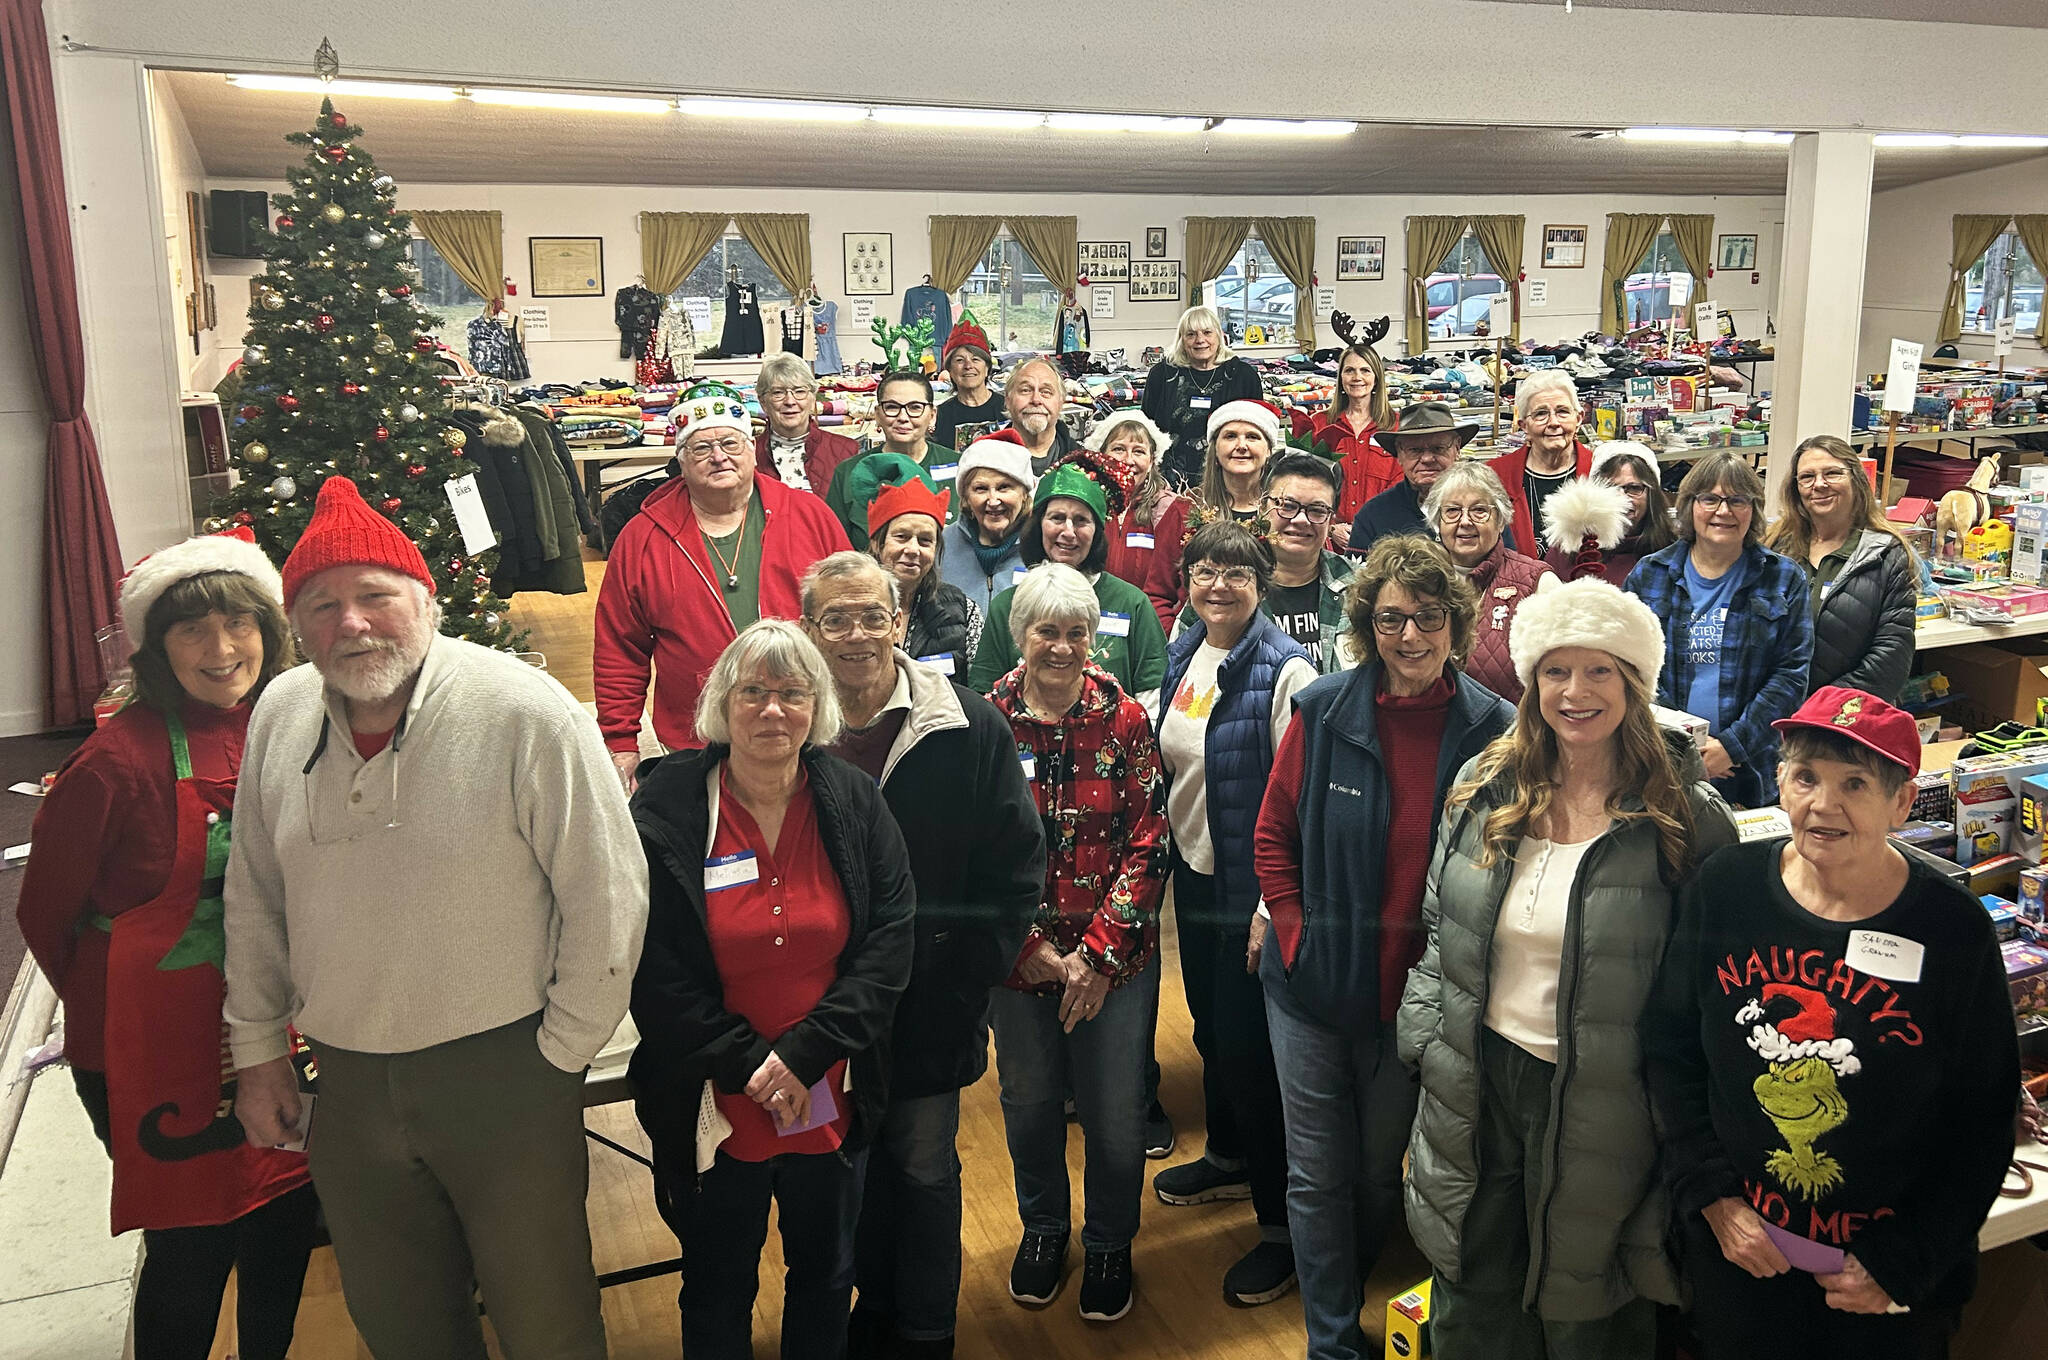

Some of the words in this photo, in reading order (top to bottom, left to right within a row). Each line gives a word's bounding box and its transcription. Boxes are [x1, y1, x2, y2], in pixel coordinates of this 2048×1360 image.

[1632, 381, 1638, 391] 3
[1647, 380, 1652, 390] 1
[455, 485, 472, 497] Bikes
[1688, 637, 1712, 650] ATS
[2022, 797, 2034, 831] CITY
[1716, 945, 1924, 1046] NAUGHTY?
